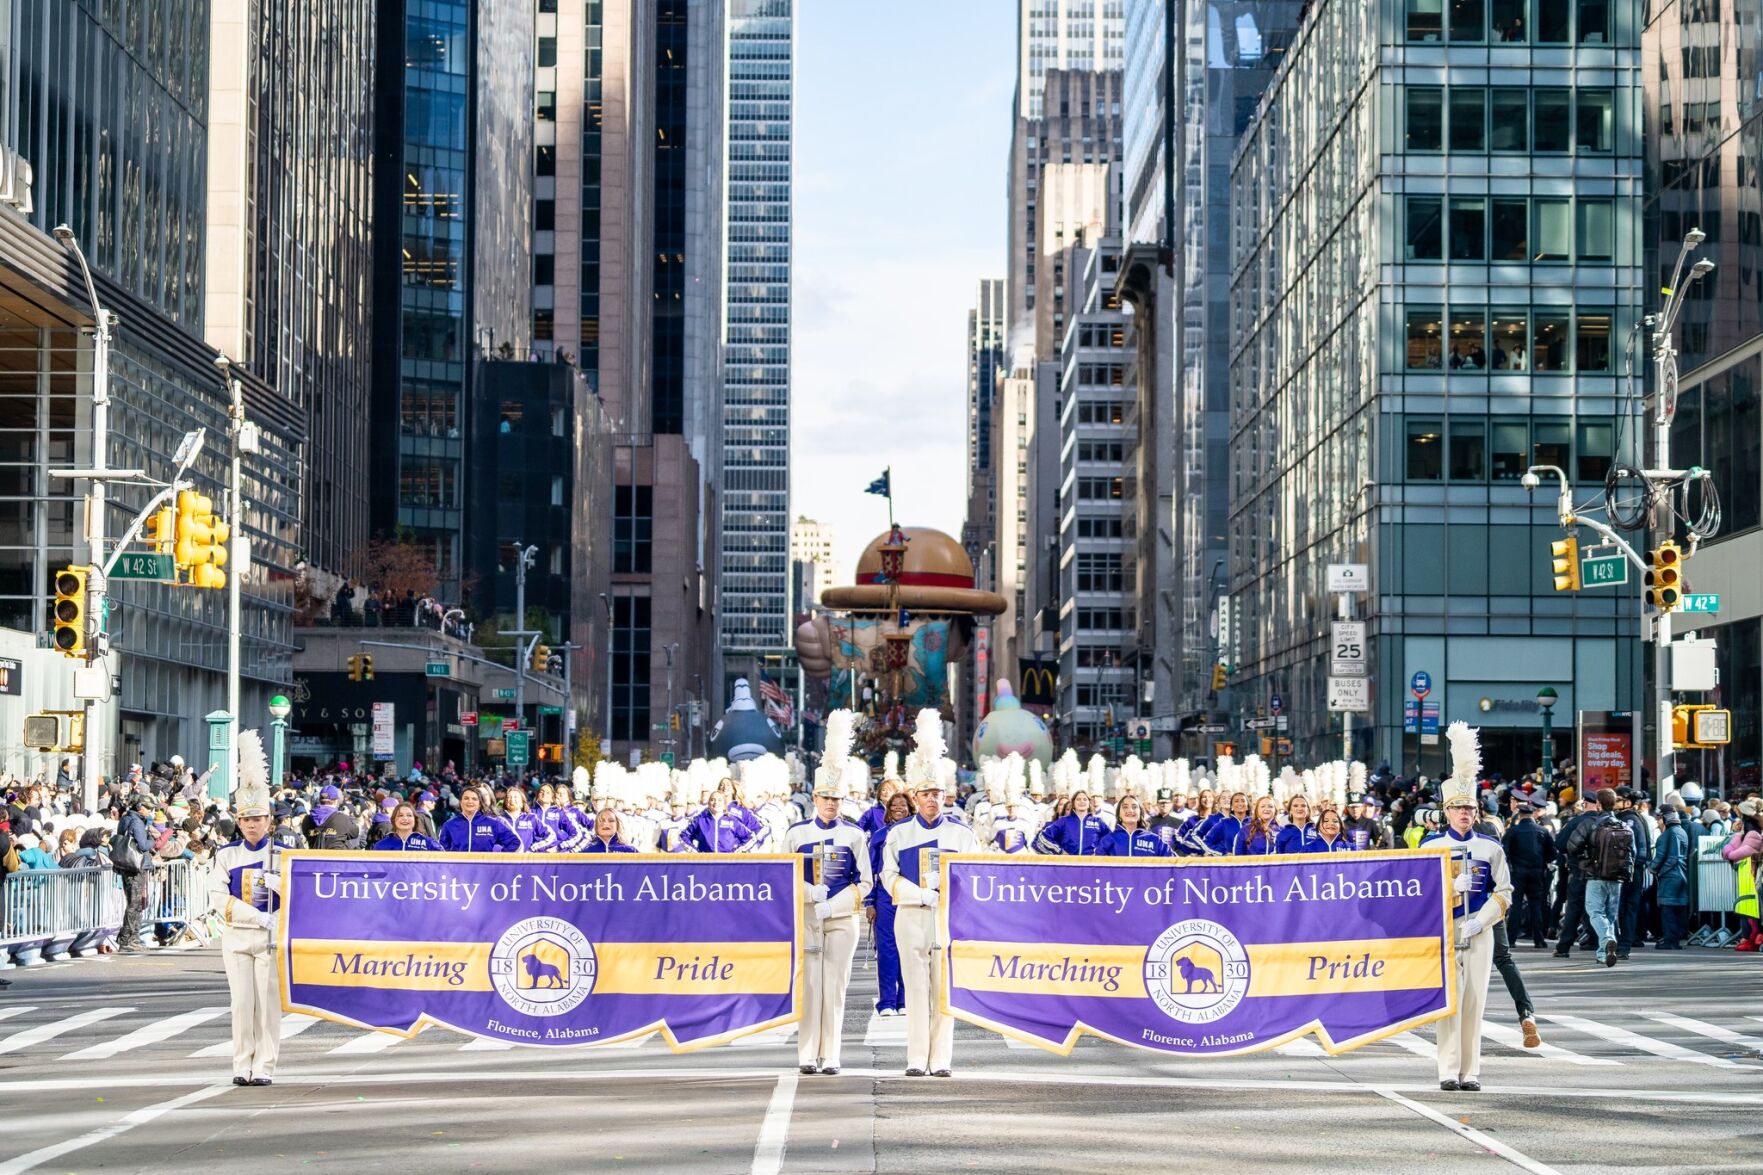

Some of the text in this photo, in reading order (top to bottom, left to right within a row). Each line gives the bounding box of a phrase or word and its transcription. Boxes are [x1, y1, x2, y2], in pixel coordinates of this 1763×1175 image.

[122, 558, 157, 575] W 42 St
[1592, 563, 1614, 580] W 42 St
[1684, 598, 1694, 610] W
[1695, 597, 1708, 610] 42
[1337, 644, 1361, 658] 25
[1335, 680, 1362, 688] BUSES
[1338, 689, 1359, 697] ONLY
[320, 708, 329, 718] &
[1588, 743, 1608, 751] Shop
[1588, 751, 1624, 759] big deals,
[1611, 760, 1626, 768] day.
[477, 825, 492, 833] UNA
[410, 837, 427, 847] UNA
[1137, 839, 1154, 849] UNA
[312, 872, 773, 911] University of North Alabama
[970, 873, 1423, 914] University of North Alabama
[501, 919, 586, 947] UNIVERSITY OF
[1156, 922, 1236, 950] UNIVERSITY OF
[330, 953, 468, 986] Marching
[496, 960, 593, 974] 18 30
[653, 956, 735, 981] Pride
[988, 954, 1123, 992] Marching
[1150, 963, 1246, 978] 18 30
[1306, 953, 1385, 981] Pride
[498, 983, 589, 1014] NORTH ALABAMA
[1153, 988, 1242, 1021] NORTH ALABAMA
[486, 1019, 600, 1039] Florence, Alabama
[1141, 1028, 1255, 1048] Florence, Alabama
